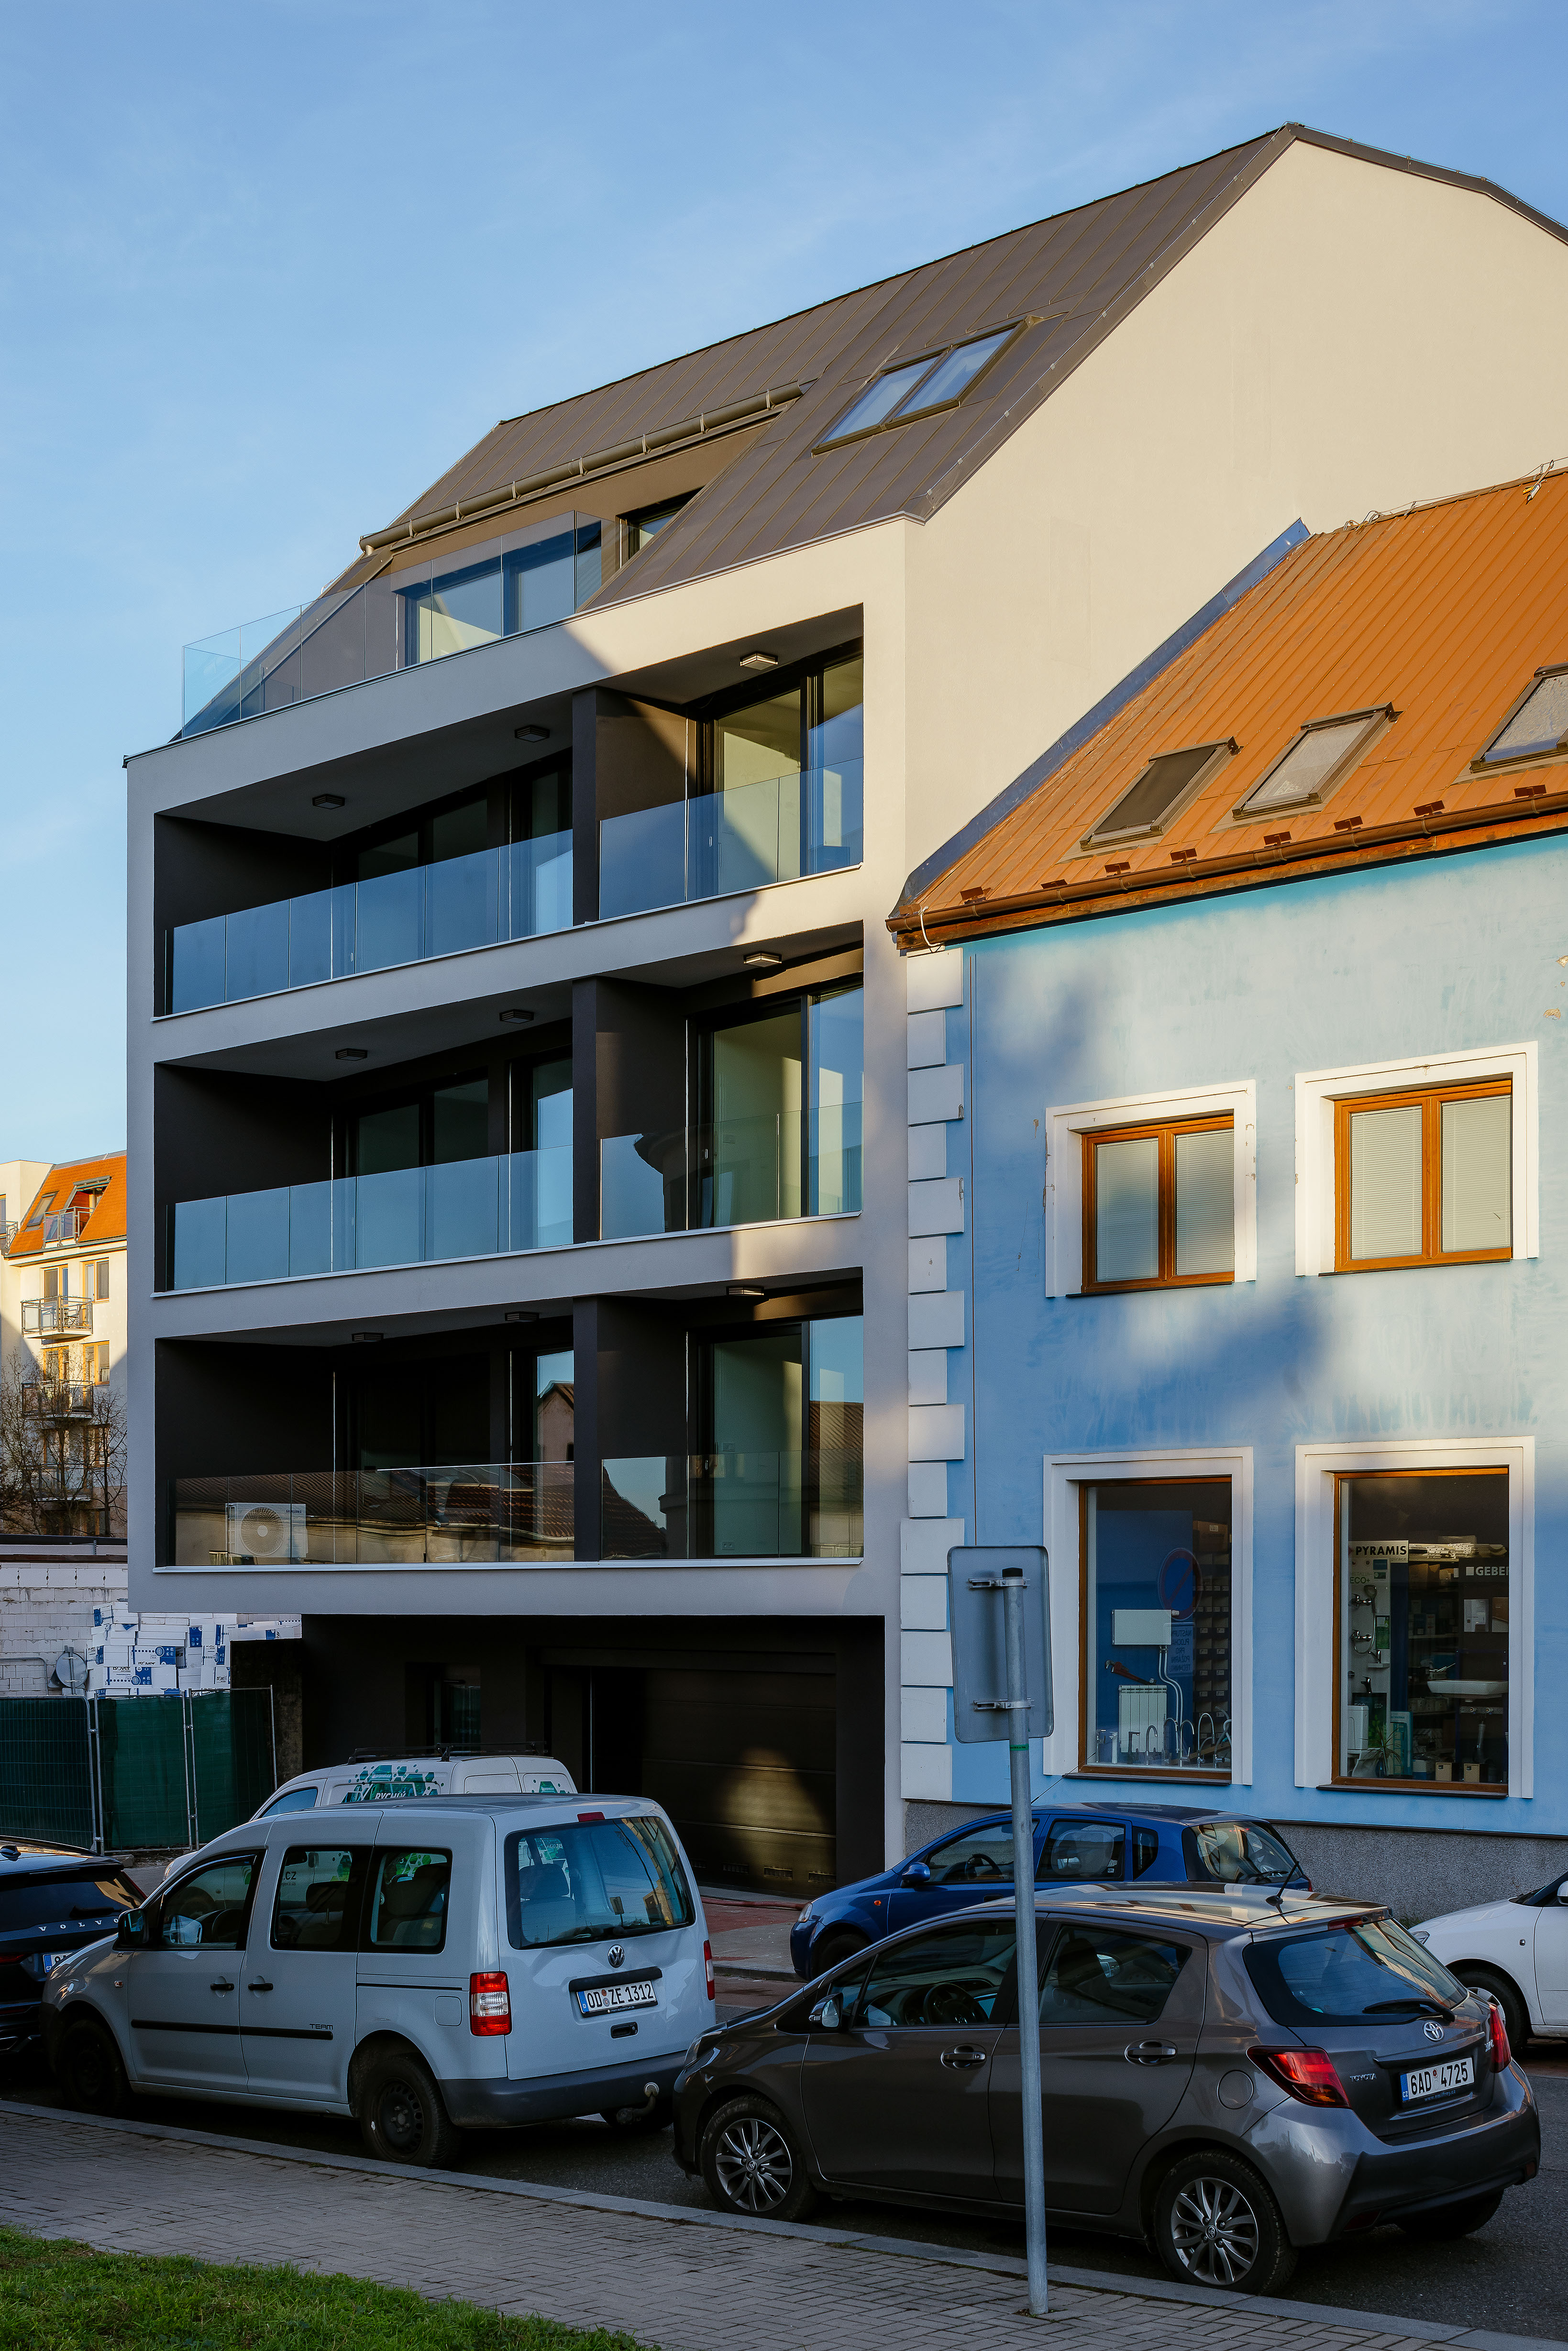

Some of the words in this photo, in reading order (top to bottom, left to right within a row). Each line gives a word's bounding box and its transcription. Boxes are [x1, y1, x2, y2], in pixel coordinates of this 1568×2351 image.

[1356, 1545, 1407, 1556] PYRAMIS
[1475, 1566, 1509, 1576] GEBE
[38, 1918, 119, 1932] VOLVO
[587, 1991, 603, 2009] OD
[608, 1987, 625, 2005] ZE
[625, 1983, 654, 2002] 1312
[1349, 2073, 1377, 2082] TOYOTA
[1410, 2069, 1432, 2096] 6AD
[1440, 2060, 1469, 2087] 4725
